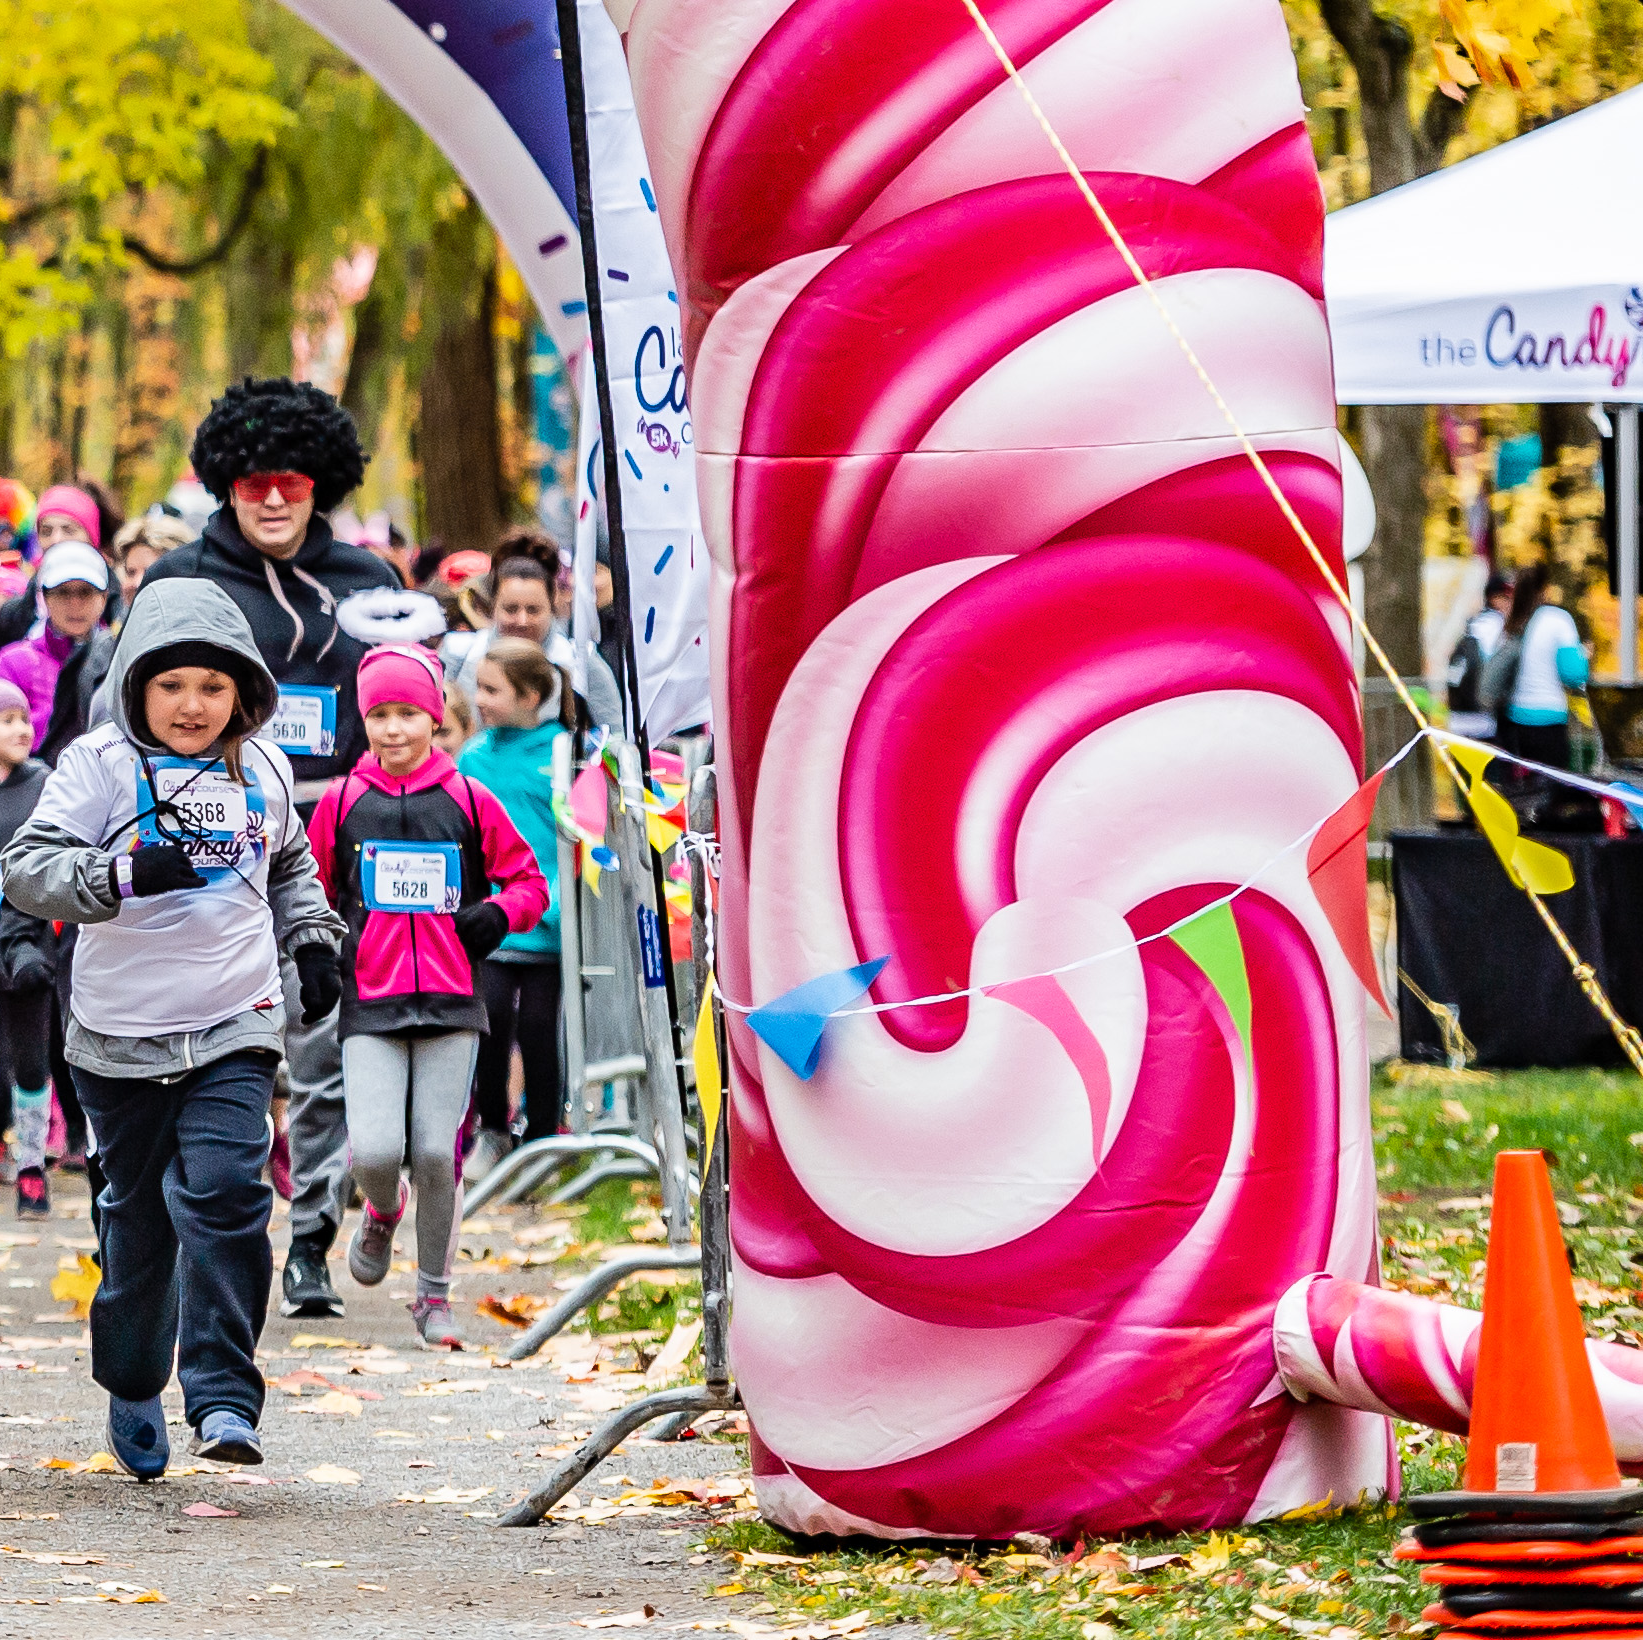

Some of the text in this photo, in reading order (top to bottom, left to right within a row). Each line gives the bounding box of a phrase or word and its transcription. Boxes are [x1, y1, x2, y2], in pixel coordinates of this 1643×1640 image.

[1421, 304, 1629, 389] the Candy
[182, 802, 226, 823] 5368
[392, 880, 428, 899] 5628
